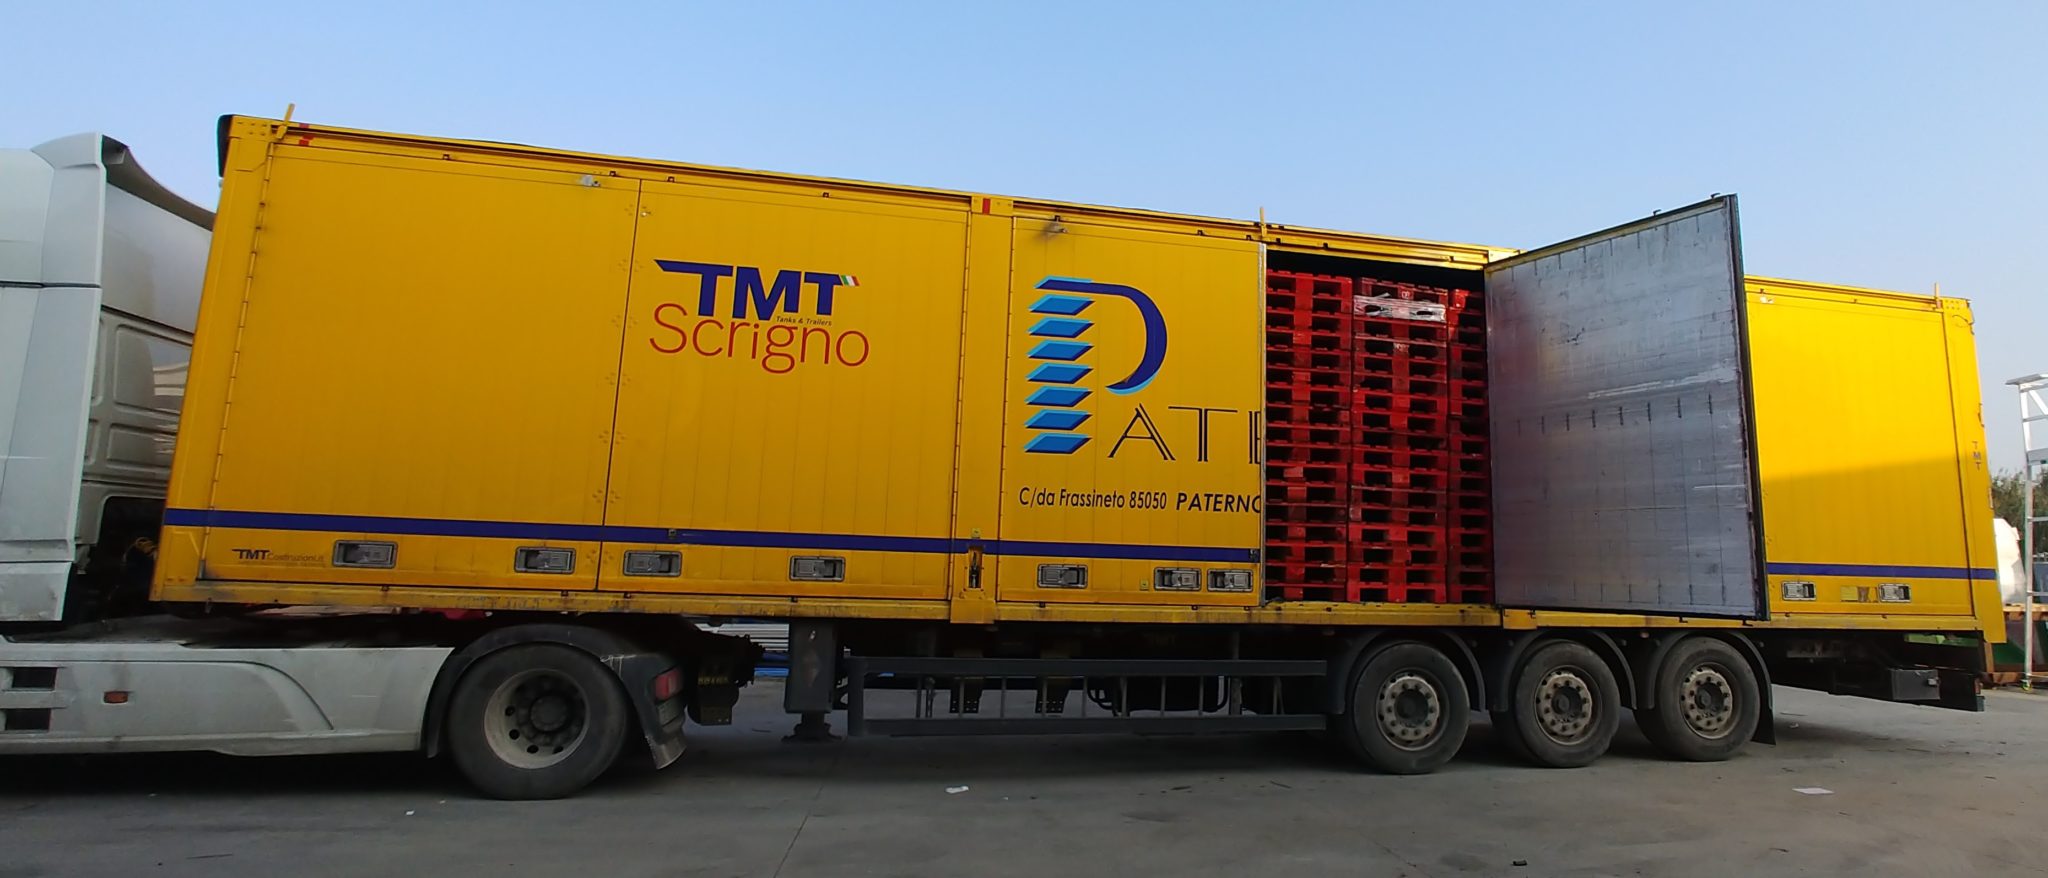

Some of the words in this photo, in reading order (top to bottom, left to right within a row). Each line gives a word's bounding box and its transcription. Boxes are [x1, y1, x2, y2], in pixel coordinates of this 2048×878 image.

[654, 259, 843, 321] TMT
[649, 303, 869, 375] Scrigno
[777, 316, 796, 324] Tanks
[806, 318, 832, 326] Trailers
[1019, 486, 1055, 508] C/da
[1059, 488, 1125, 508] Frassineto
[1129, 491, 1167, 509] 85050
